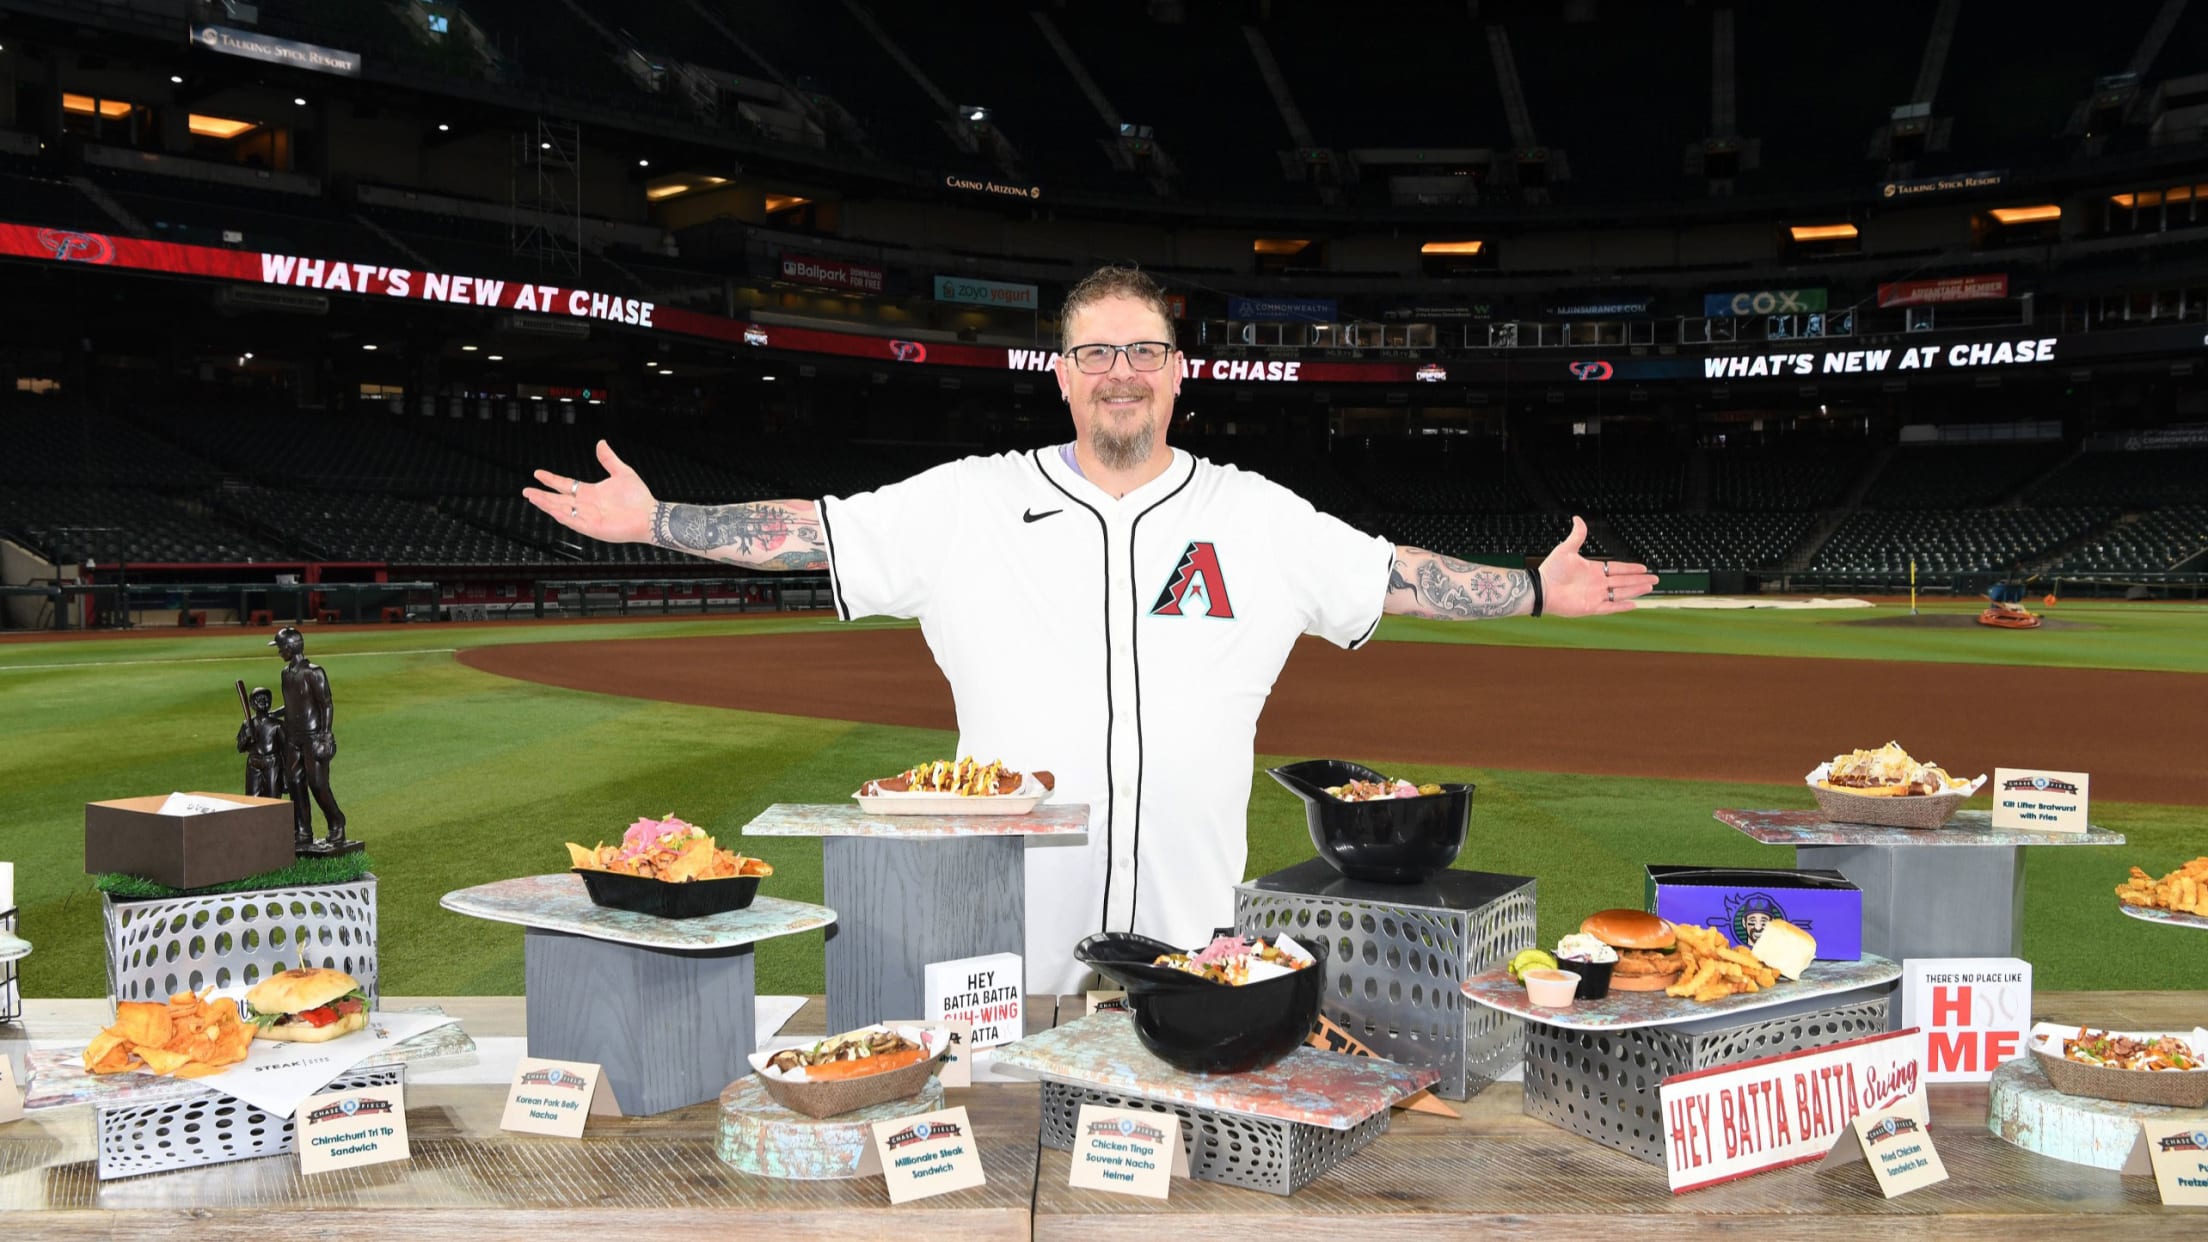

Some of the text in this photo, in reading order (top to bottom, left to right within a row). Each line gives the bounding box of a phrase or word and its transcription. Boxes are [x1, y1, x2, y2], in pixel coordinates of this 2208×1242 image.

[797, 263, 847, 290] Ballpark
[849, 268, 882, 280] DOWNLOAD
[261, 253, 654, 327] WHAT'S NEW AT CHASE
[849, 277, 881, 290] FOR FREE
[990, 286, 1031, 305] yogurt
[1731, 291, 1799, 315] COX
[1255, 303, 1328, 313] COMMONWEALTH
[1705, 338, 2057, 379] WHAT'S NEW AT CHASE
[1212, 359, 1301, 382] CHASE
[1148, 540, 1236, 620] A
[2017, 801, 2036, 809] Lifter
[2038, 803, 2076, 812] Bratwurst
[2019, 811, 2058, 821] with Fries
[968, 970, 995, 991] HEY
[1926, 973, 2022, 983] THERE'S NO PLACE LIKE
[944, 986, 1018, 1011] BATTA BATTA
[971, 1026, 999, 1043] ATTA
[254, 1061, 301, 1072] STEAK
[515, 1095, 579, 1111] Korean Pork Belly
[313, 1107, 339, 1118] CHASE
[529, 1110, 558, 1120] Nachos
[1669, 1058, 1920, 1172] HEY BATTA BATTA Swing
[311, 1127, 394, 1146] Chimichurri Tri Tip
[891, 1133, 914, 1144] CHASE
[330, 1142, 377, 1157] Sandwich
[1091, 1139, 1154, 1156] Chicken Tinga
[1896, 1145, 1922, 1158] Chicken
[894, 1146, 964, 1168] Millionaire Steak
[1086, 1153, 1156, 1170] Souvenir Nacho
[912, 1163, 954, 1179] Sandwich
[1103, 1170, 1135, 1182] Helmet
[1887, 1161, 1916, 1176] Sandwich
